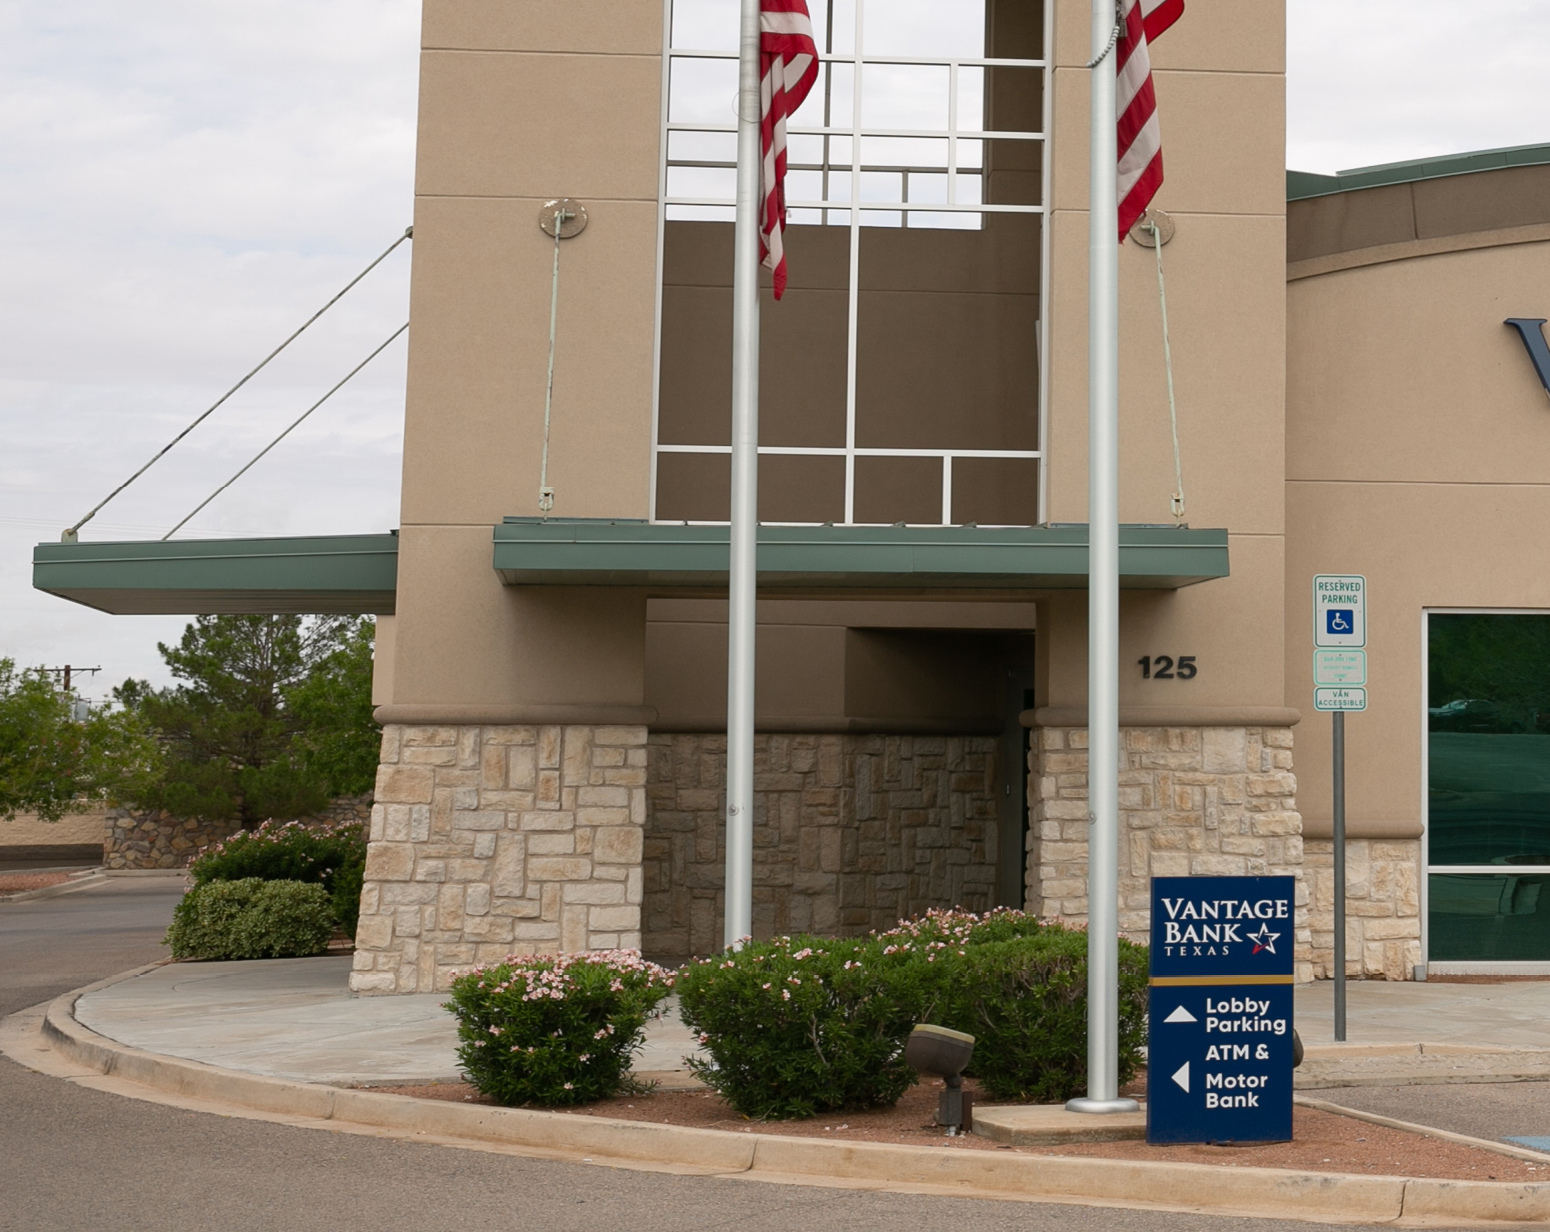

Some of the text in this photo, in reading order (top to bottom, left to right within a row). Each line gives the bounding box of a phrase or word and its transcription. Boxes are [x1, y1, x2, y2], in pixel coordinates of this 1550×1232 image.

[1318, 582, 1361, 592] RESERVED
[1322, 594, 1358, 604] PARKING
[1138, 655, 1198, 679] 125
[1161, 898, 1289, 920] VANTAGE
[1164, 921, 1243, 944] BANK
[1164, 946, 1229, 956] TEXAS
[1206, 997, 1270, 1016] Lobby
[1206, 1016, 1286, 1035] Parking
[1205, 1043, 1269, 1061] ATM &
[1206, 1073, 1268, 1089] Motor
[1206, 1092, 1259, 1109] Bank
